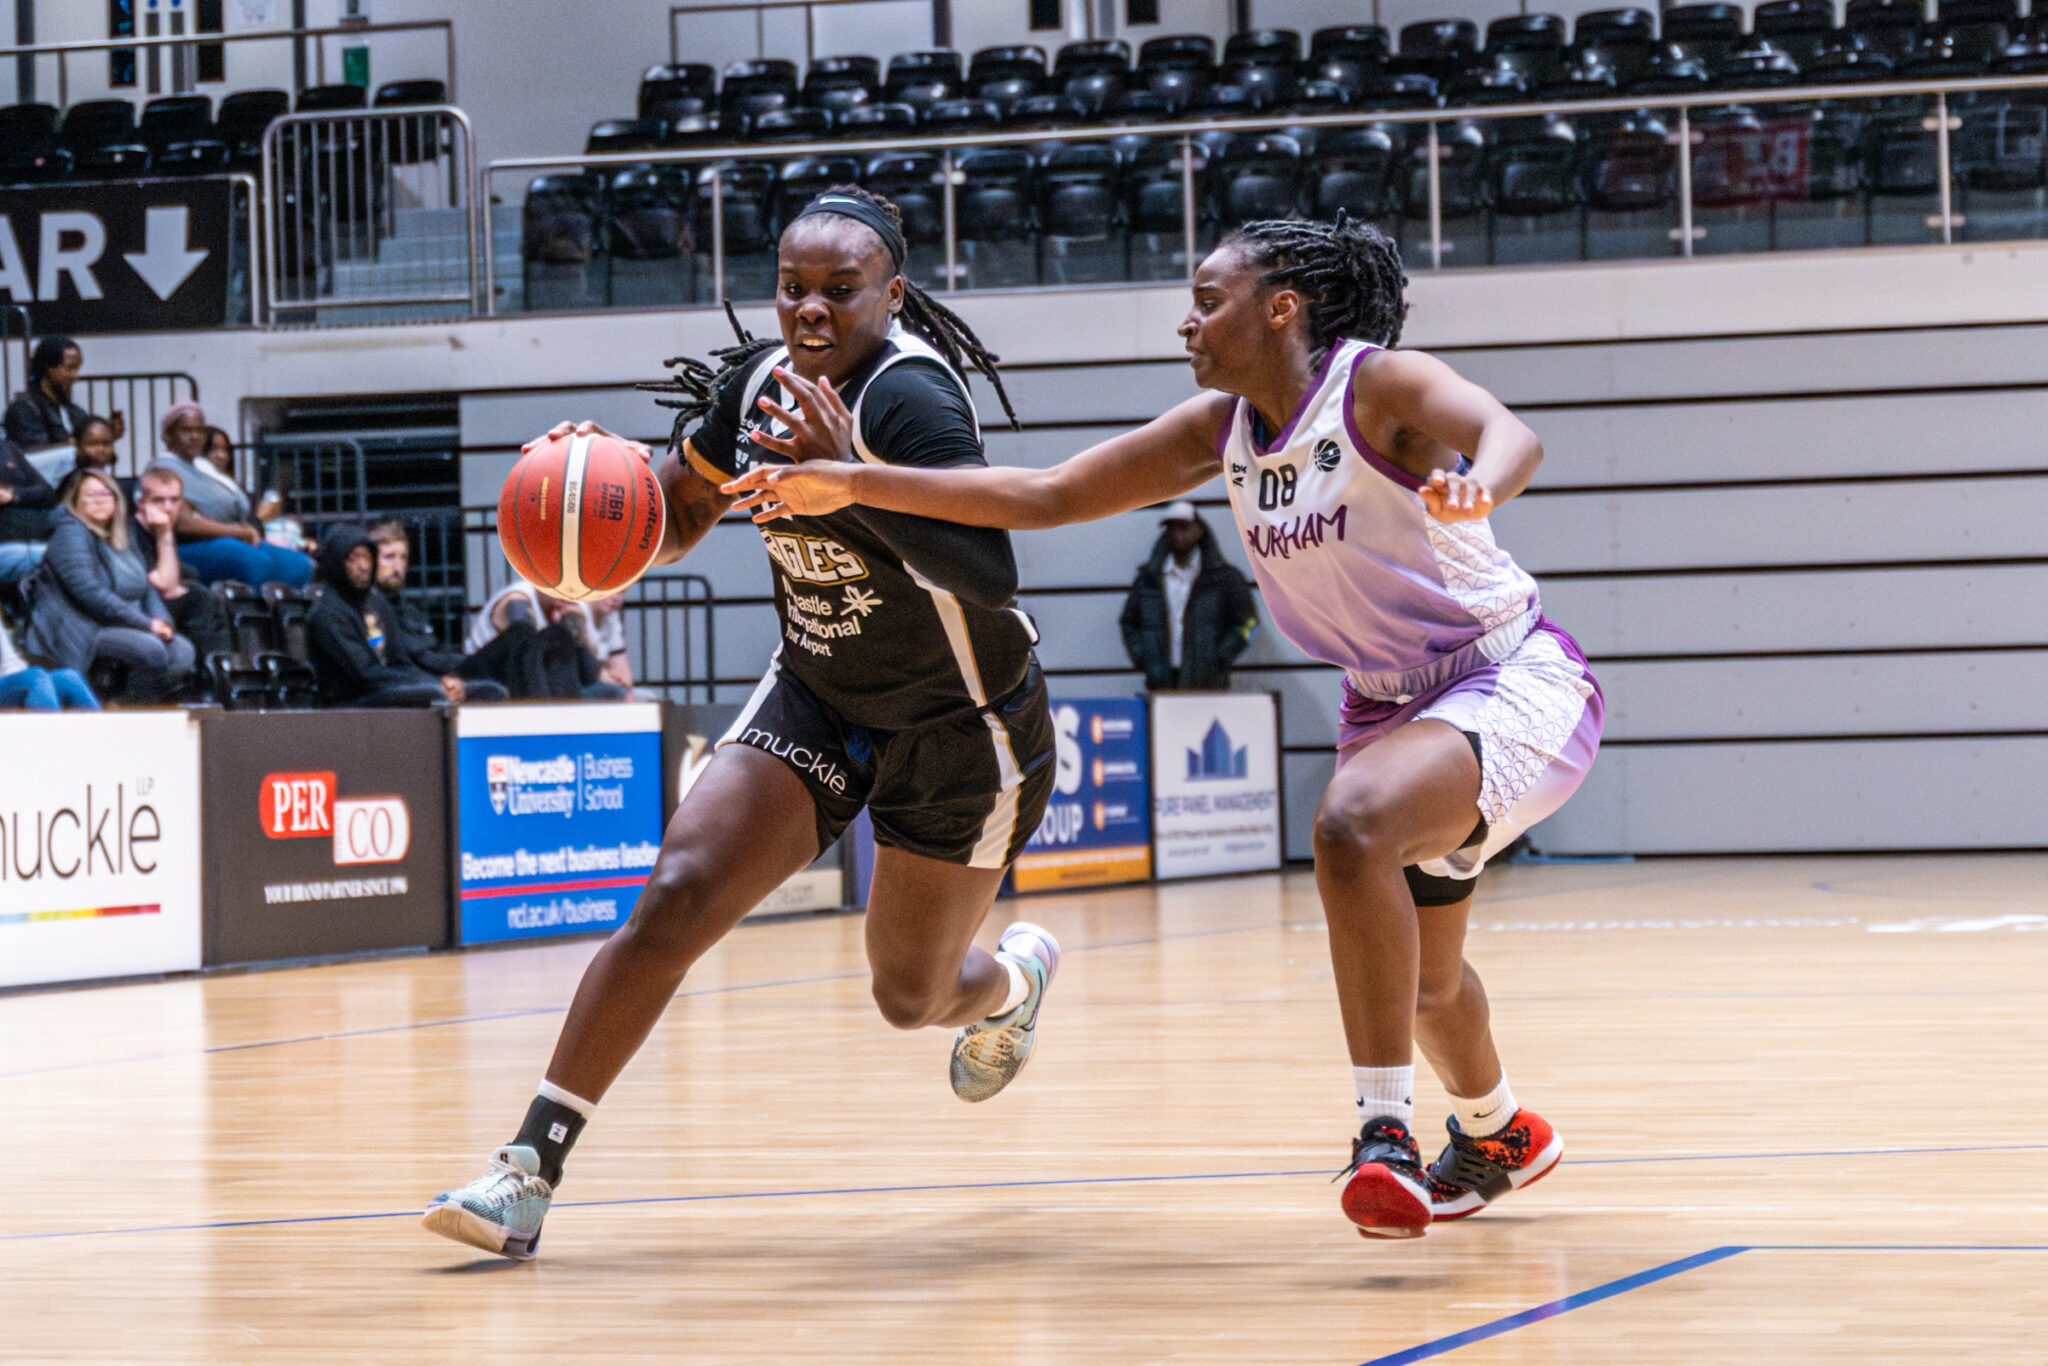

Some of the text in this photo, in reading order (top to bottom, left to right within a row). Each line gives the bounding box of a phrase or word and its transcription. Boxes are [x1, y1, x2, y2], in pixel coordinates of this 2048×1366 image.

[608, 484, 625, 522] FIBA
[639, 477, 658, 550] molten
[760, 529, 865, 582] AGLES
[740, 727, 847, 795] muckle
[1050, 705, 1083, 796] S
[0, 782, 161, 881] uckle
[271, 779, 331, 833] PER
[348, 806, 394, 859] CO
[461, 851, 515, 881] Become
[515, 847, 538, 877] the
